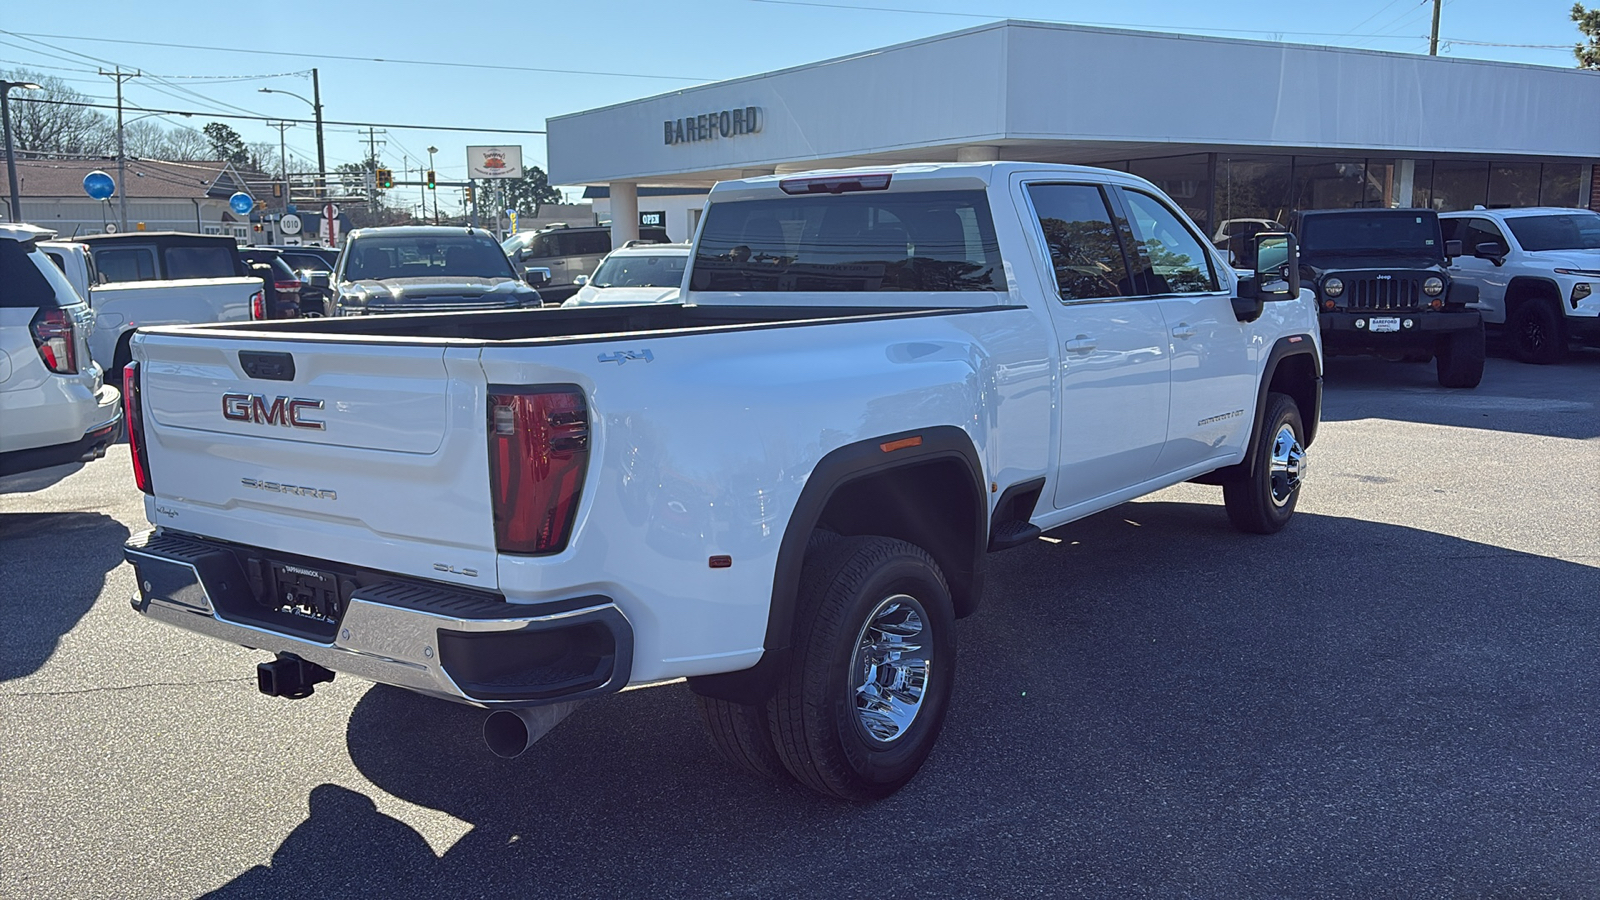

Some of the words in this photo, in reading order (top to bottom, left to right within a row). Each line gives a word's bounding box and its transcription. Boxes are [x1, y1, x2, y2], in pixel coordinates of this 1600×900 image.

[663, 106, 763, 146] BAREFORD
[282, 220, 299, 229] 1010
[642, 214, 660, 225] OPEN
[222, 391, 326, 431] GMC
[241, 477, 338, 501] SIERRA
[285, 565, 319, 577] TAPPAHANNOCK
